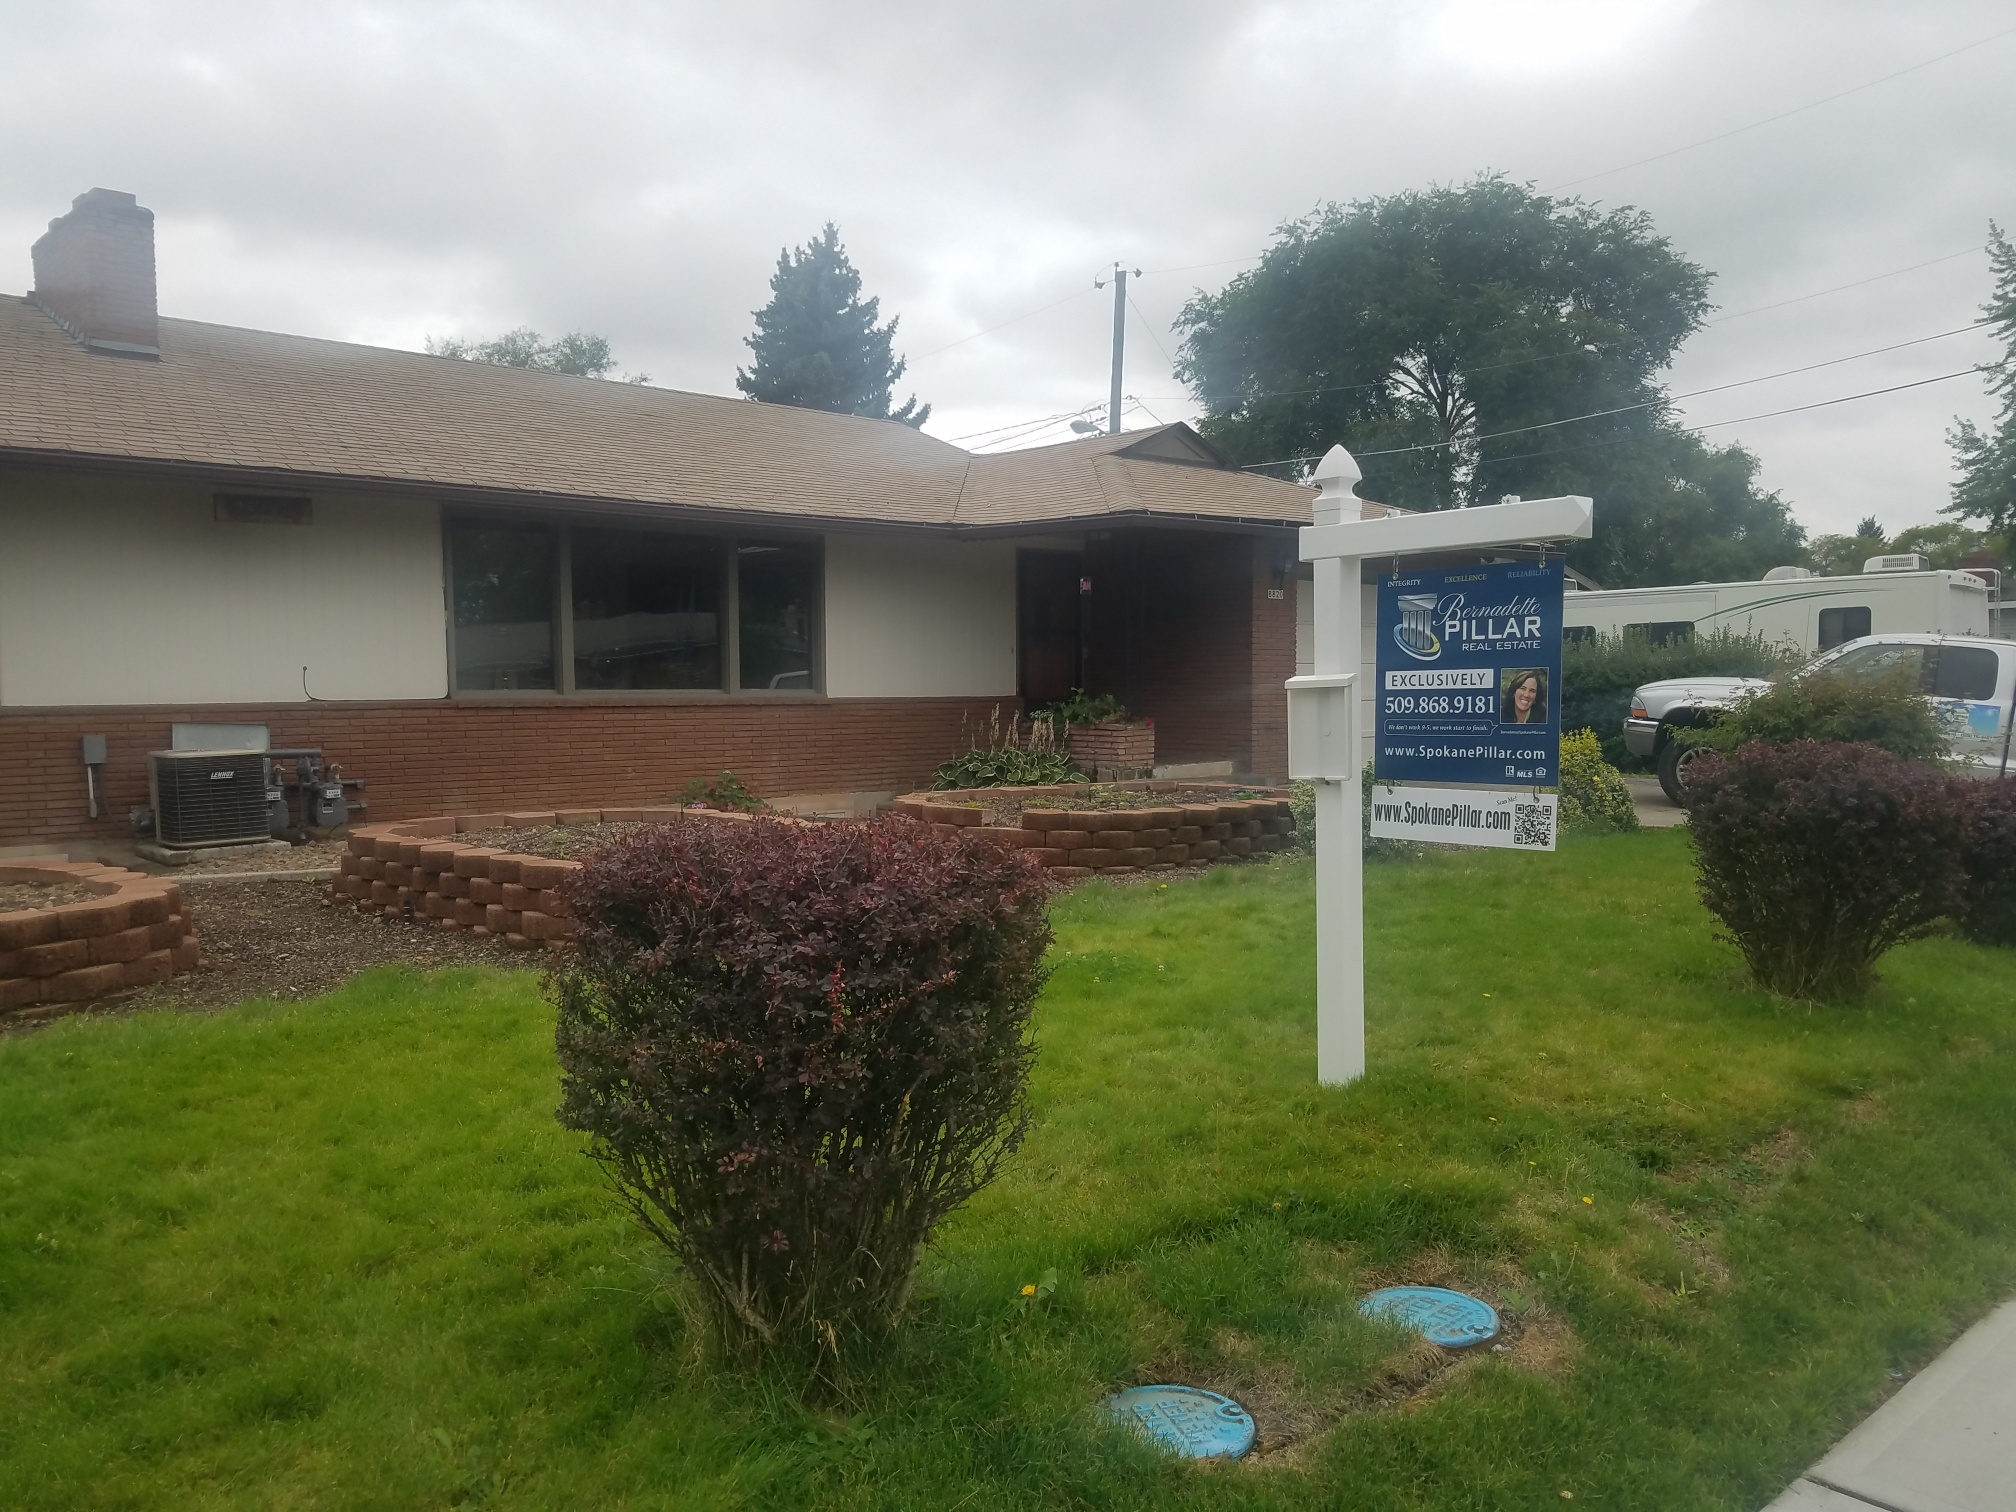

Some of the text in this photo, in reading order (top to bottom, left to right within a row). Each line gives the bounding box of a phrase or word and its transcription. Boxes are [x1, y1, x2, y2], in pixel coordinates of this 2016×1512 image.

[1387, 568, 1551, 587] INTEGRITY EXCELLENCE RELIABILITY
[1432, 592, 1542, 626] Bernadette
[1444, 616, 1542, 641] PILLAR
[1462, 640, 1541, 651] REAL ESTATE
[1391, 672, 1486, 687] EXCLUSIVELY
[1384, 696, 1495, 714] 509.868.9181
[1384, 745, 1545, 760] www.SpokanePillar.com
[1374, 801, 1511, 831] www.SpokanePillar.com
